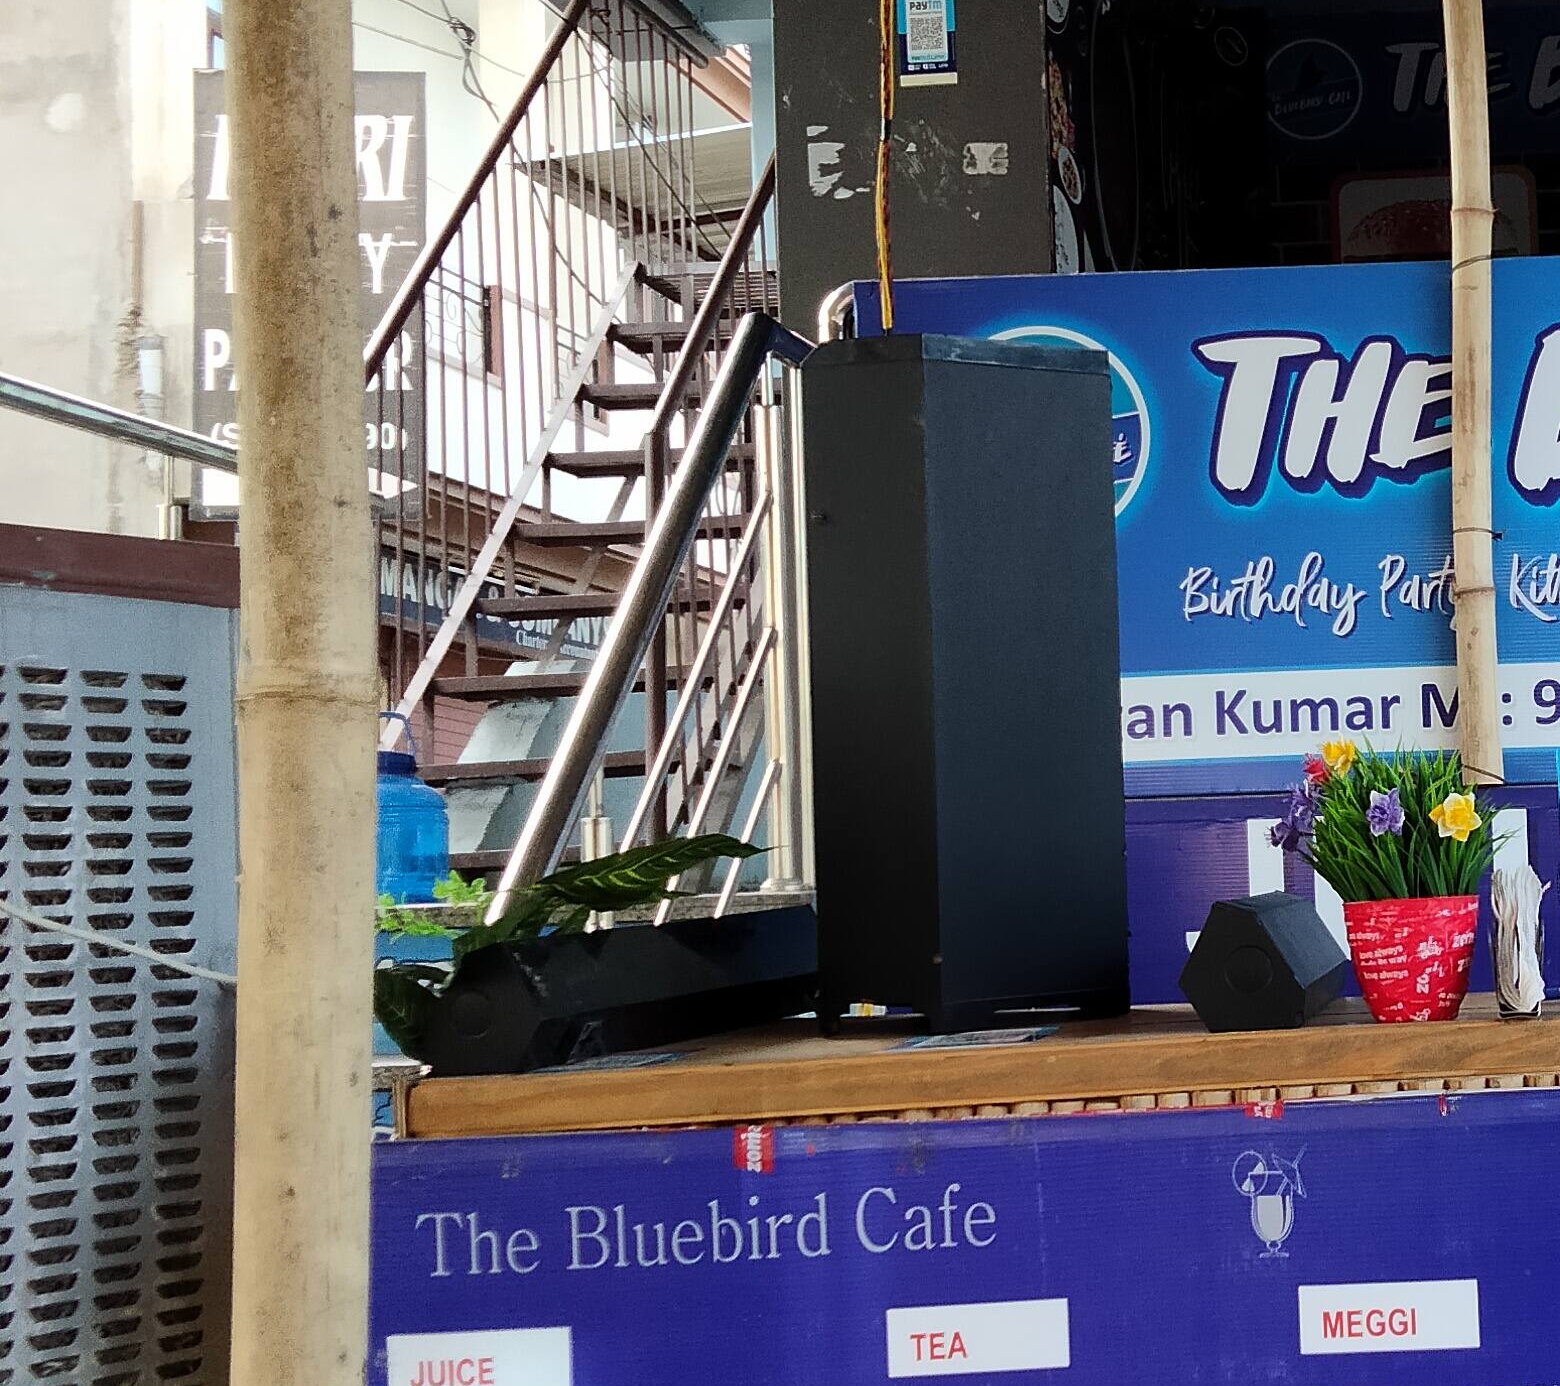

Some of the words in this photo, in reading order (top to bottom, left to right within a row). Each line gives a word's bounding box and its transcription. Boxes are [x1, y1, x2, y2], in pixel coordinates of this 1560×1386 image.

[1203, 333, 1453, 495] THE
[1180, 551, 1368, 637] Birthday
[1377, 553, 1456, 631] Part
[1126, 698, 1193, 740] an
[1215, 688, 1401, 736] Kumar
[414, 1211, 539, 1277] The
[564, 1192, 830, 1270] Bluebird
[855, 1182, 997, 1253] Cafe
[910, 1330, 967, 1361] TEA
[1321, 1306, 1417, 1339] MEGGI
